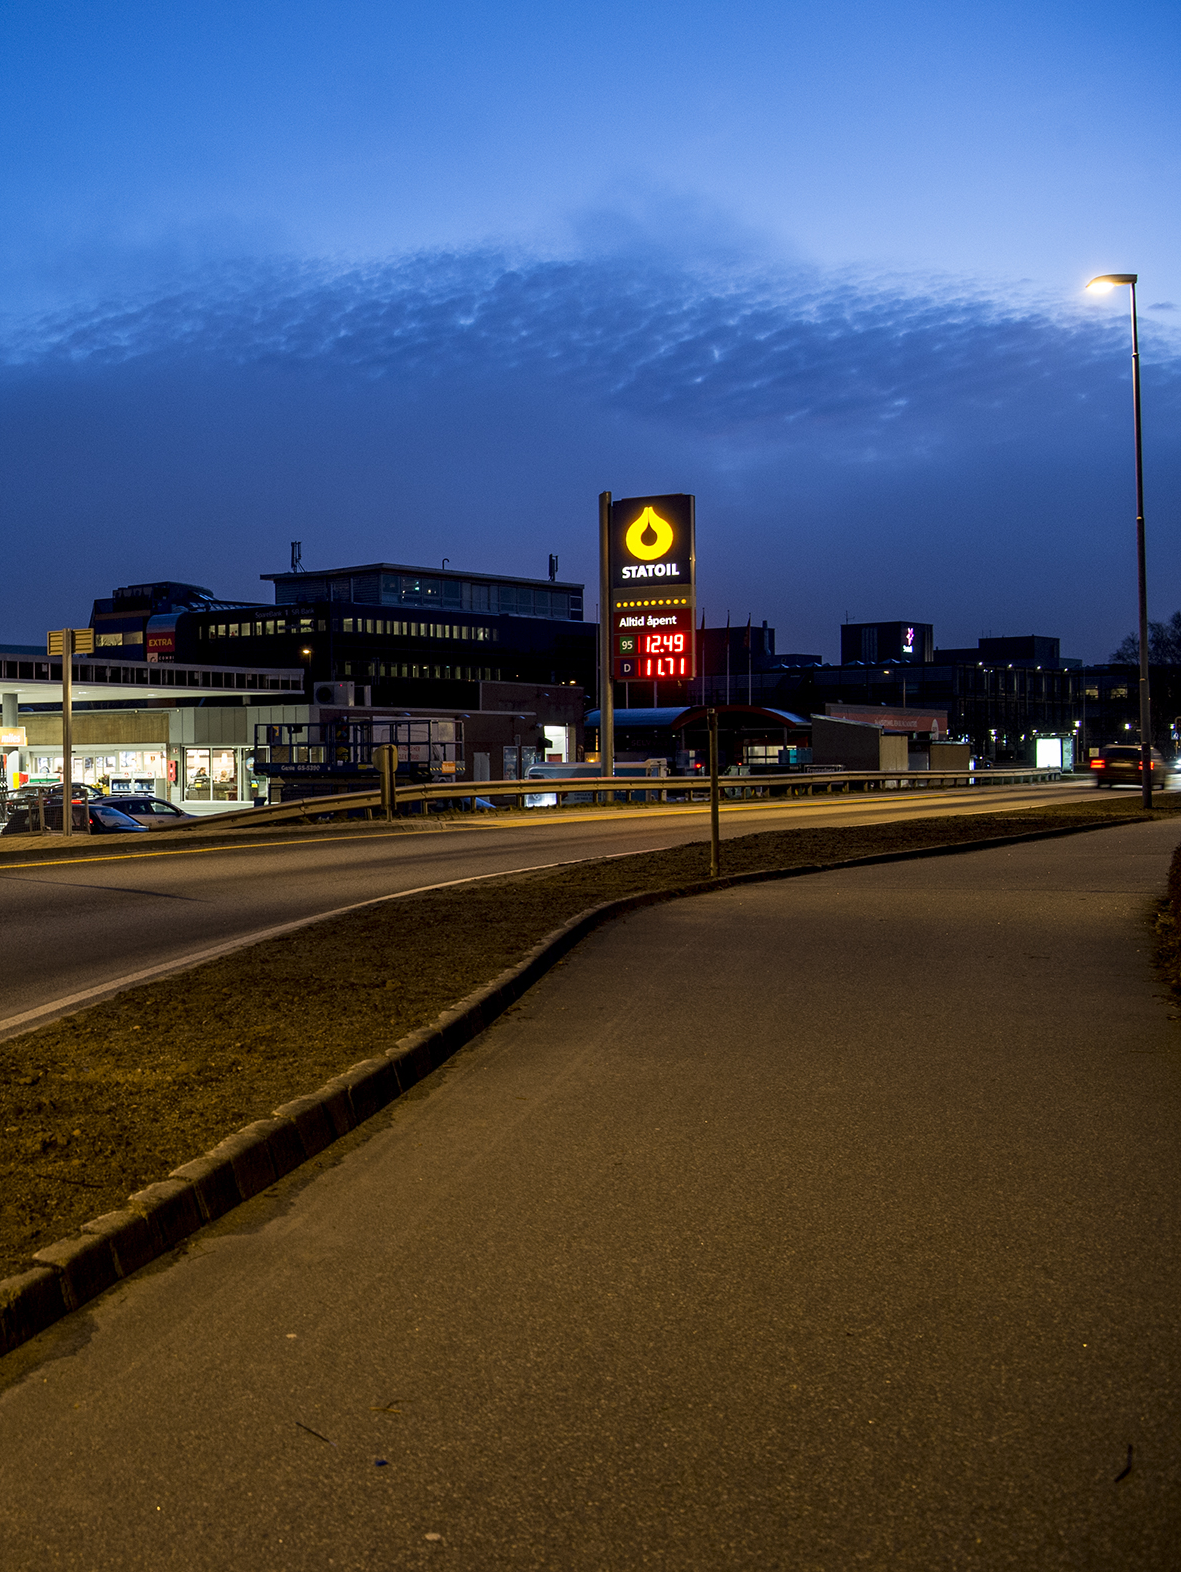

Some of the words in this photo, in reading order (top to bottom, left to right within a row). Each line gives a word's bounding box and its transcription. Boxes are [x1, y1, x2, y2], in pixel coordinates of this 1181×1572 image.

[622, 564, 680, 579] STATOIL
[619, 616, 645, 628] Alltid
[647, 615, 677, 628] åpent
[148, 638, 172, 647] EXTRA
[622, 640, 633, 650] 95
[646, 634, 684, 653] 12.49
[624, 664, 631, 672] D
[647, 658, 684, 676] 11.71
[1, 734, 20, 743] miles
